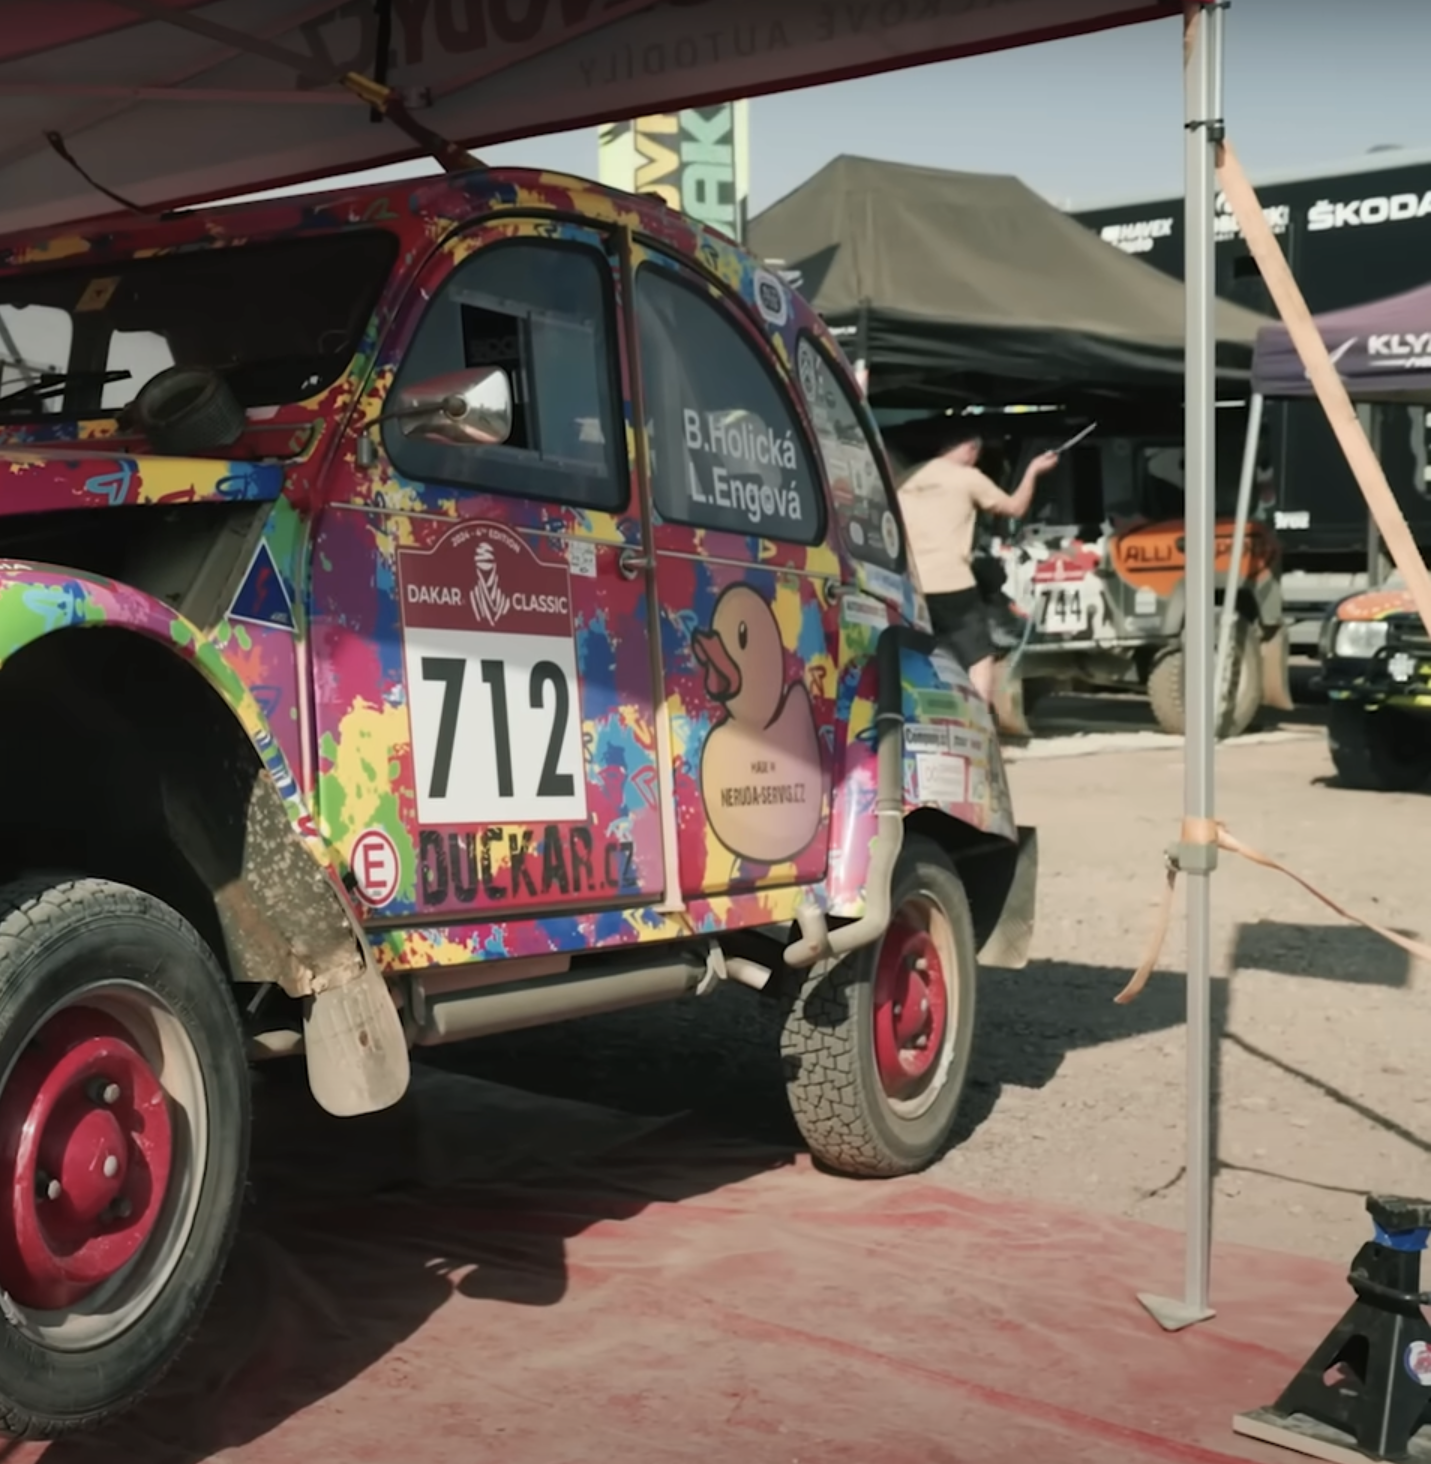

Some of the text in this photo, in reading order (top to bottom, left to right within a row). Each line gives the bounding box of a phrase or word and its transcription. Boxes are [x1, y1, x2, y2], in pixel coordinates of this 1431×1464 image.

[1367, 332, 1431, 355] KLY
[683, 408, 798, 470] B.Holická
[689, 461, 803, 523] L.Engová
[407, 583, 568, 614] DAKAR CLASSIC
[1040, 588, 1082, 625] 744
[420, 656, 575, 798] 712
